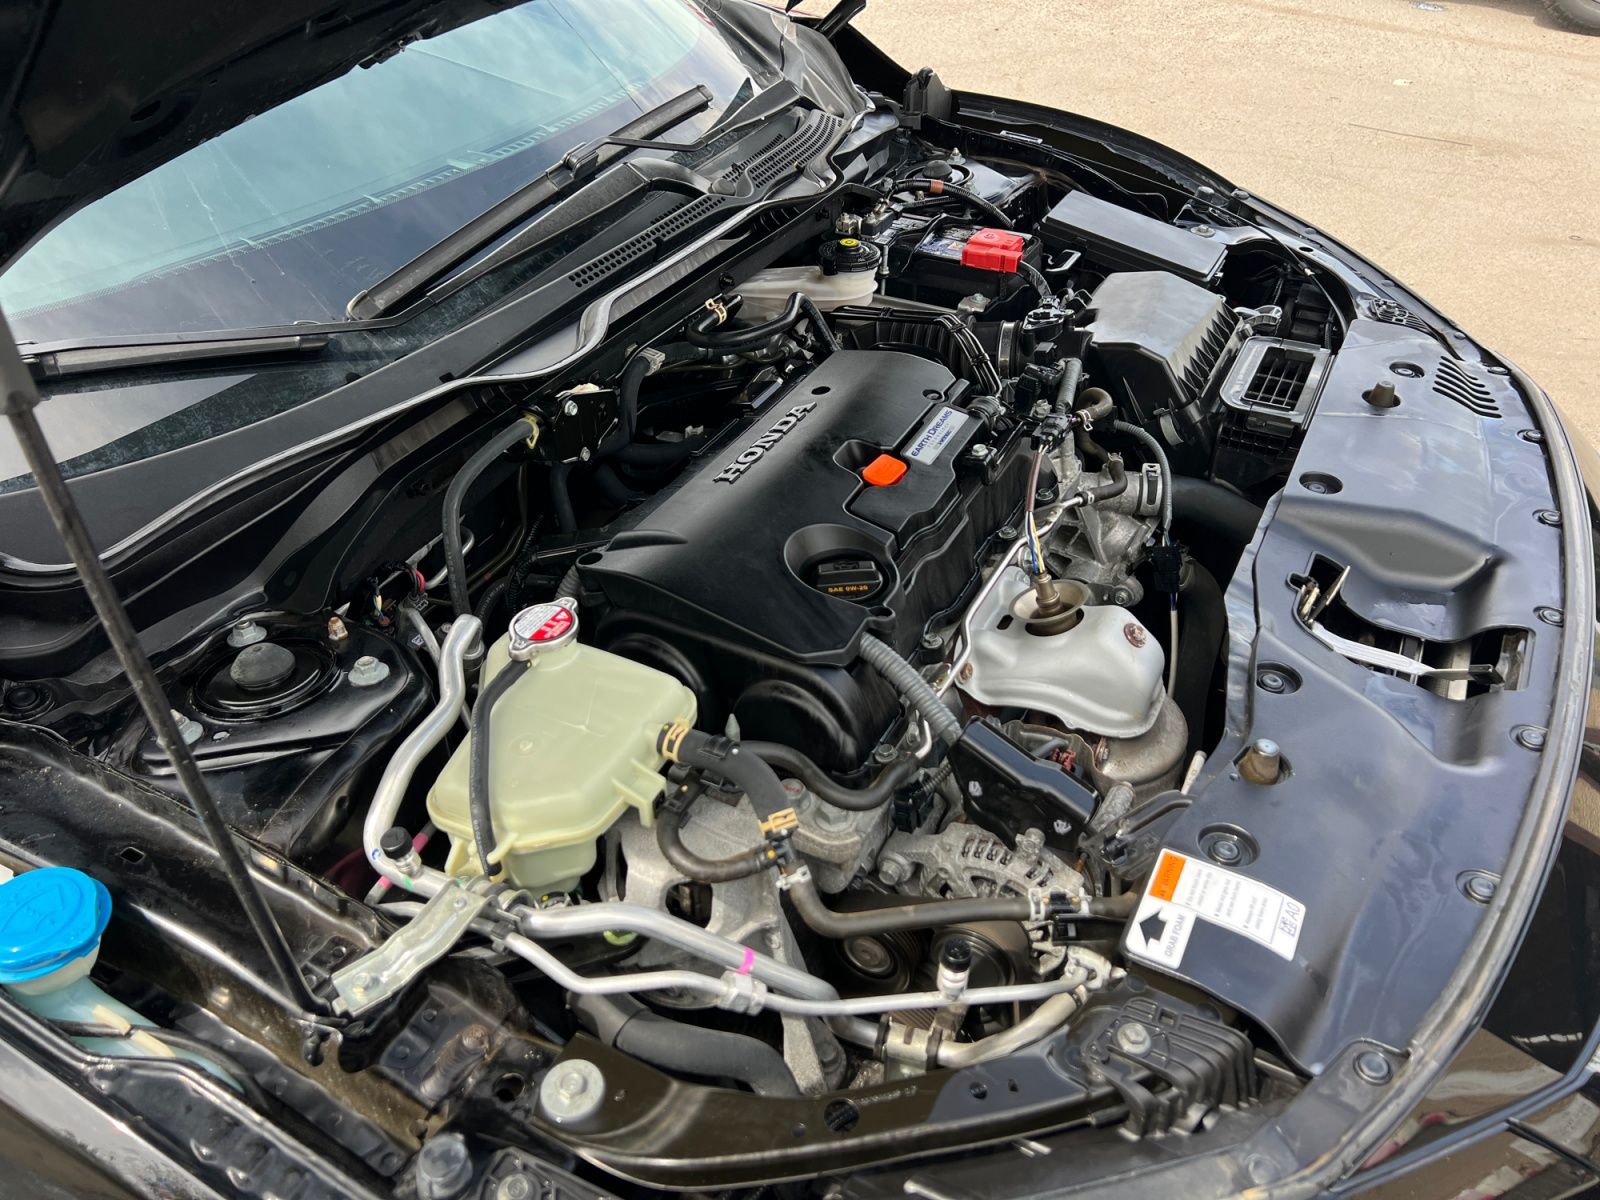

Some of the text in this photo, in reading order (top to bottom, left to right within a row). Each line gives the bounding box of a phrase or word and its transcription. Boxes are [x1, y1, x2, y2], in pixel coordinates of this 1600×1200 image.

[713, 401, 817, 484] HONDA
[910, 432, 931, 457] EARTH
[928, 409, 952, 437] DREAMS
[1164, 913, 1186, 957] GRAB FOAM
